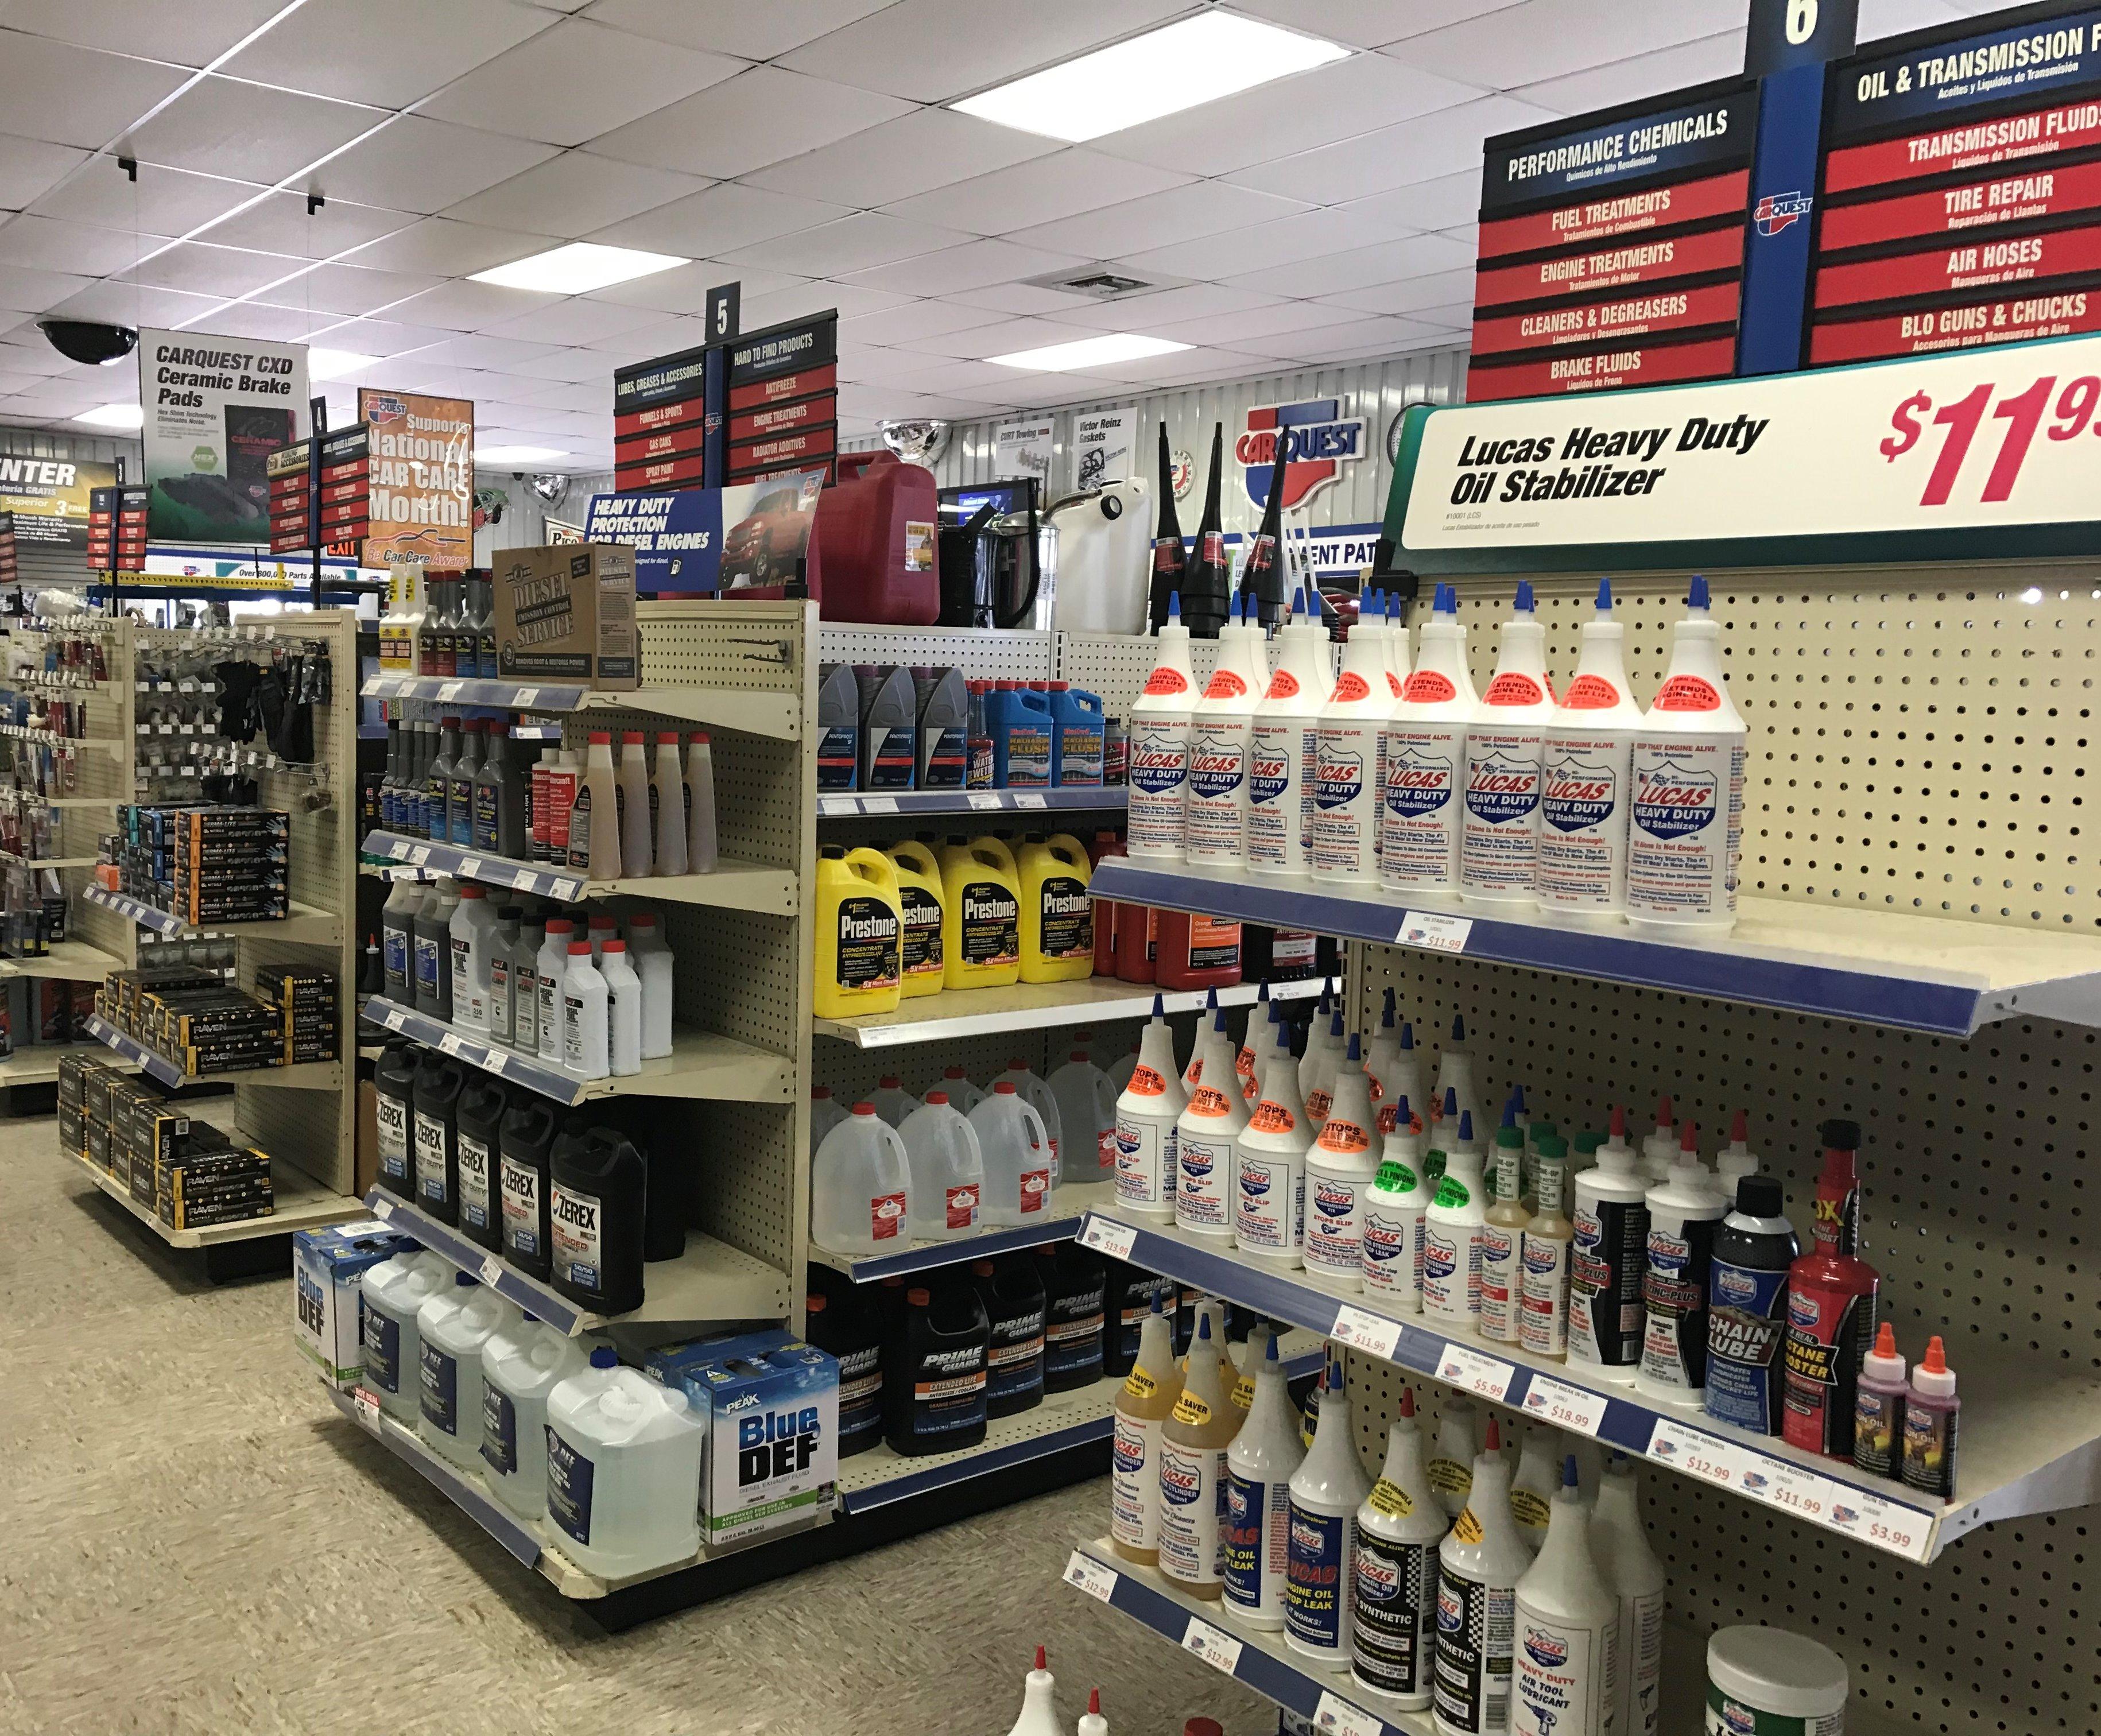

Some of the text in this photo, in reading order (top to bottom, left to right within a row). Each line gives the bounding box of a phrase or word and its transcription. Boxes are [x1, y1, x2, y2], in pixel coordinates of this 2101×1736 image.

[1785, 0, 1818, 45] 6
[1858, 72, 1890, 102] OIL
[1895, 65, 1912, 94] &
[1917, 27, 2084, 88] TRANSMISSION
[1937, 84, 1968, 100] Aceites
[1970, 84, 1975, 96] y
[2014, 73, 2025, 84] de
[2027, 61, 2079, 81] Transmisión
[1508, 109, 1728, 181] PERFORMANCE CHEMICALS
[1908, 104, 2101, 163] TRANSMISSION FLUID
[1944, 174, 2054, 214] TIRE REPAIR
[1552, 190, 1670, 231] FUEL TREATMENTS
[1564, 216, 1656, 242] Tratamientos de Combustible
[1541, 242, 1674, 283] ENGINE TREATMENTS
[1946, 238, 2042, 274] AIR HOSES
[717, 298, 727, 335] 5
[1521, 294, 1687, 336] CLEANERS & DEGREASERS
[1901, 293, 2087, 338] BLO GUNS & CHUCKS
[156, 346, 293, 375] CARQUEST CXD
[734, 351, 751, 366] HARD
[753, 348, 761, 361] TO
[762, 342, 777, 358] FIND
[778, 332, 813, 355] PRODUCTS
[1551, 351, 1641, 379] BRAKE FLUIDS
[157, 366, 292, 395] Ceramic Brake
[636, 376, 660, 392] GREASES
[661, 374, 665, 386] &
[666, 363, 703, 383] ACCESSORIES
[765, 377, 797, 395] ANTIFREEZE
[157, 388, 203, 408] Pads
[317, 406, 322, 432] 4
[407, 413, 468, 435] Supports
[660, 408, 665, 418] &
[754, 405, 807, 428] ENGINE TREATMENTS
[1079, 417, 1121, 432] Victor Reinz
[369, 428, 468, 463] National
[649, 436, 672, 451] GAS CANS
[753, 437, 806, 458] RADIATOR ADDITIVES
[1079, 432, 1106, 444] Gaskets
[1235, 423, 1362, 463] CARQUEST
[1457, 413, 1771, 468] Lucas Heavy Duty
[0, 458, 76, 487] NTER
[369, 461, 468, 492] CAR CARE
[646, 462, 674, 479] SPRAY PAINT
[26, 486, 56, 496] GRATIS
[1449, 464, 1667, 505] Oil Stabilizer
[6, 496, 49, 507] Superior
[55, 499, 88, 516] 3 FREE
[369, 488, 468, 528] Month!
[594, 497, 676, 516] HEAVY DUTY
[590, 516, 668, 533] PROTECTION
[1442, 524, 1456, 532] Lucas
[328, 540, 356, 555] EXIT
[615, 533, 653, 551] DIESEL
[656, 532, 710, 551] ENGINES
[366, 549, 380, 561] Be
[383, 549, 403, 562] Car
[405, 551, 430, 564] Care
[239, 569, 307, 580] Over Parts
[1638, 786, 1712, 807] LUCAS
[1636, 807, 1710, 820] HEAVY DUTY
[1640, 819, 1700, 831] Oil Stabilizer
[965, 898, 1015, 919] Prestone
[1045, 893, 1090, 913] Prestone
[841, 915, 896, 939] Prestone
[842, 945, 883, 953] CONCENTRATE
[1427, 935, 1462, 950] $11.99
[193, 1022, 227, 1034] RAVEN
[1326, 1122, 1361, 1136] STOPS
[504, 1165, 534, 1200] ZEREX
[558, 1194, 596, 1231] ZEREX
[1336, 1216, 1353, 1226] SLIP
[1104, 1239, 1129, 1256] $13.99
[574, 1264, 593, 1276] 50/50
[1709, 1314, 1771, 1344] CHAIN
[922, 1345, 983, 1367] PRIME
[1708, 1331, 1762, 1361] LUBE
[941, 1358, 980, 1372] GUARD
[1458, 1350, 1497, 1369] FUEL TREATMENT
[929, 1379, 963, 1391] EXTENDED
[1474, 1378, 1503, 1397] $5.99
[726, 1393, 761, 1415] PEAK
[739, 1406, 819, 1451] Blue
[1550, 1406, 1589, 1428] $18.99
[739, 1432, 818, 1487] DEF
[1686, 1455, 1730, 1482] $12.99
[1762, 1458, 1815, 1482] OCTANE BOOSTER
[1774, 1487, 1821, 1514] $11.99
[1869, 1522, 1911, 1548] $3.99
[1304, 1596, 1333, 1610] LEAK
[1318, 1587, 1334, 1599] OIL
[1359, 1599, 1412, 1625] SYNTHETIC
[1518, 1683, 1571, 1708] LUBRICANT
[1521, 1673, 1565, 1698] AIR TOOL
